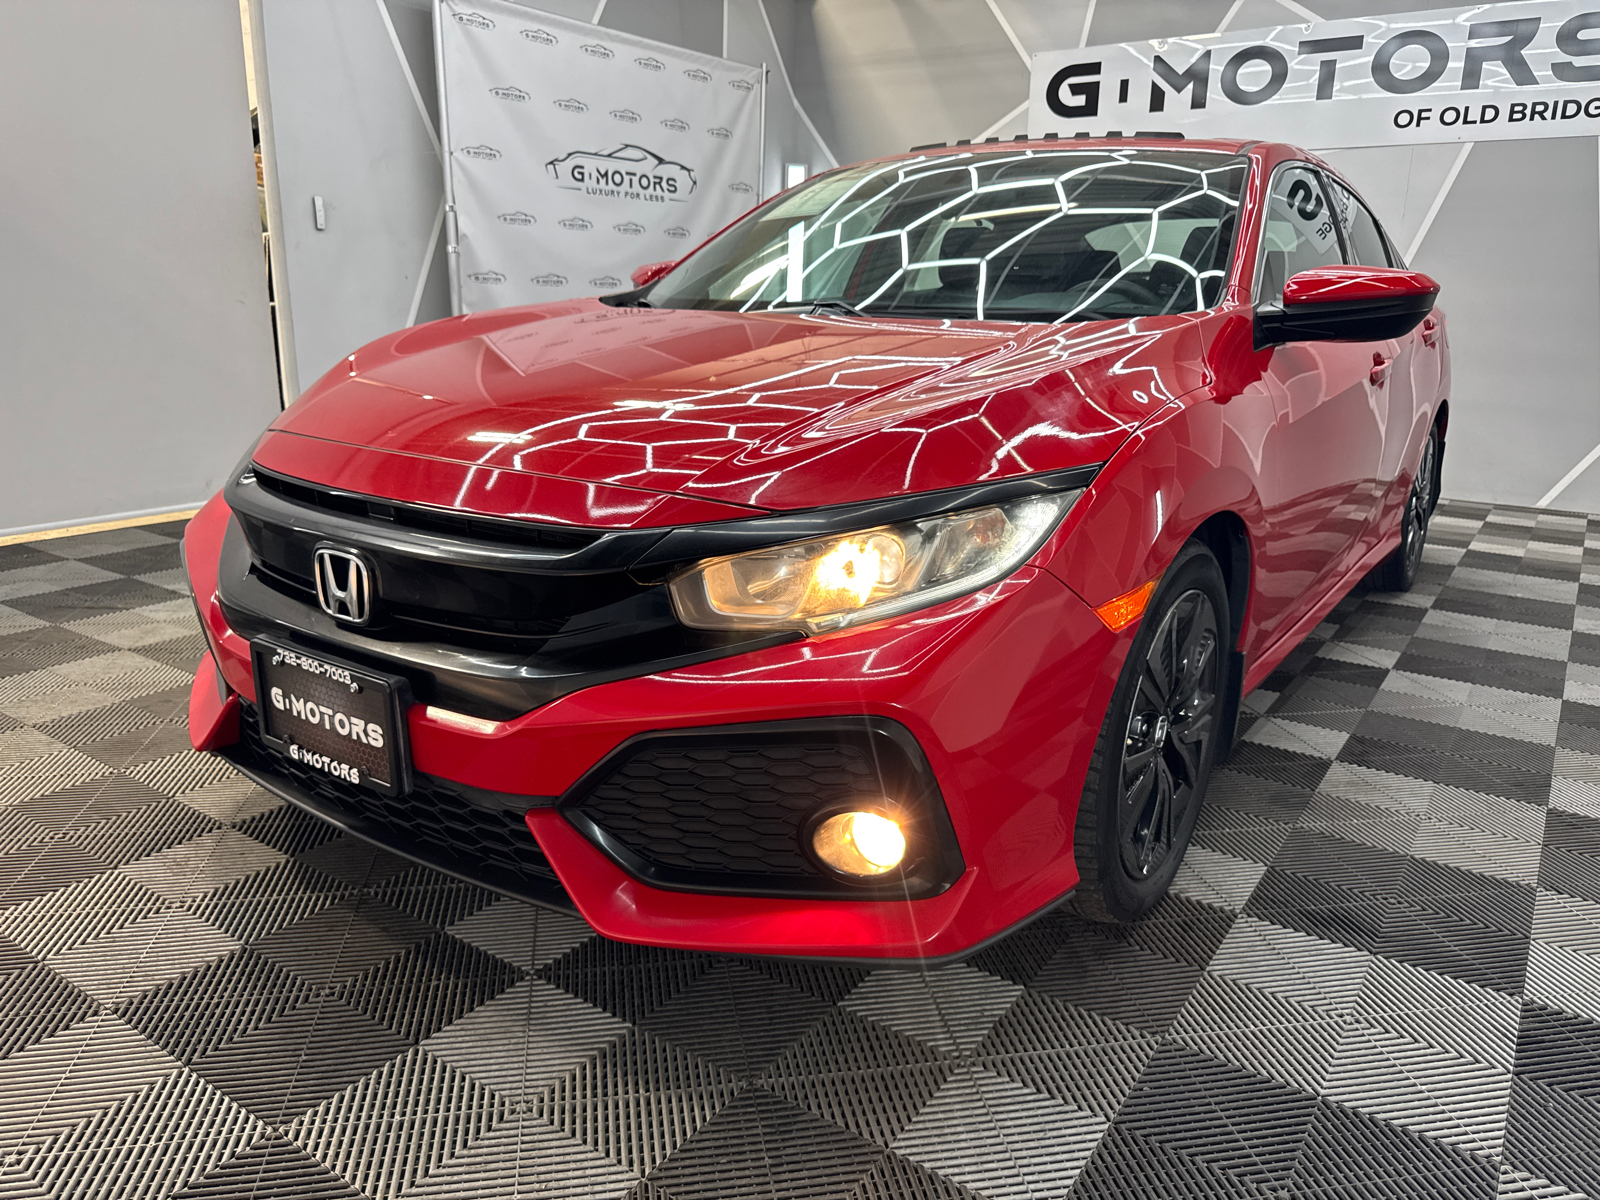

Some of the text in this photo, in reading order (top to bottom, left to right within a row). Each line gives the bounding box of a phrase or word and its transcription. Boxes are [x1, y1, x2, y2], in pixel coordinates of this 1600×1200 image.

[1149, 11, 1600, 113] MOTORS
[1393, 108, 1432, 129] OF
[1439, 104, 1500, 126] OLD
[586, 187, 665, 203] LUXURY FOR LESS
[596, 166, 678, 194] MOTORS
[290, 693, 384, 748] MOTORS
[302, 747, 360, 785] MOTORS
